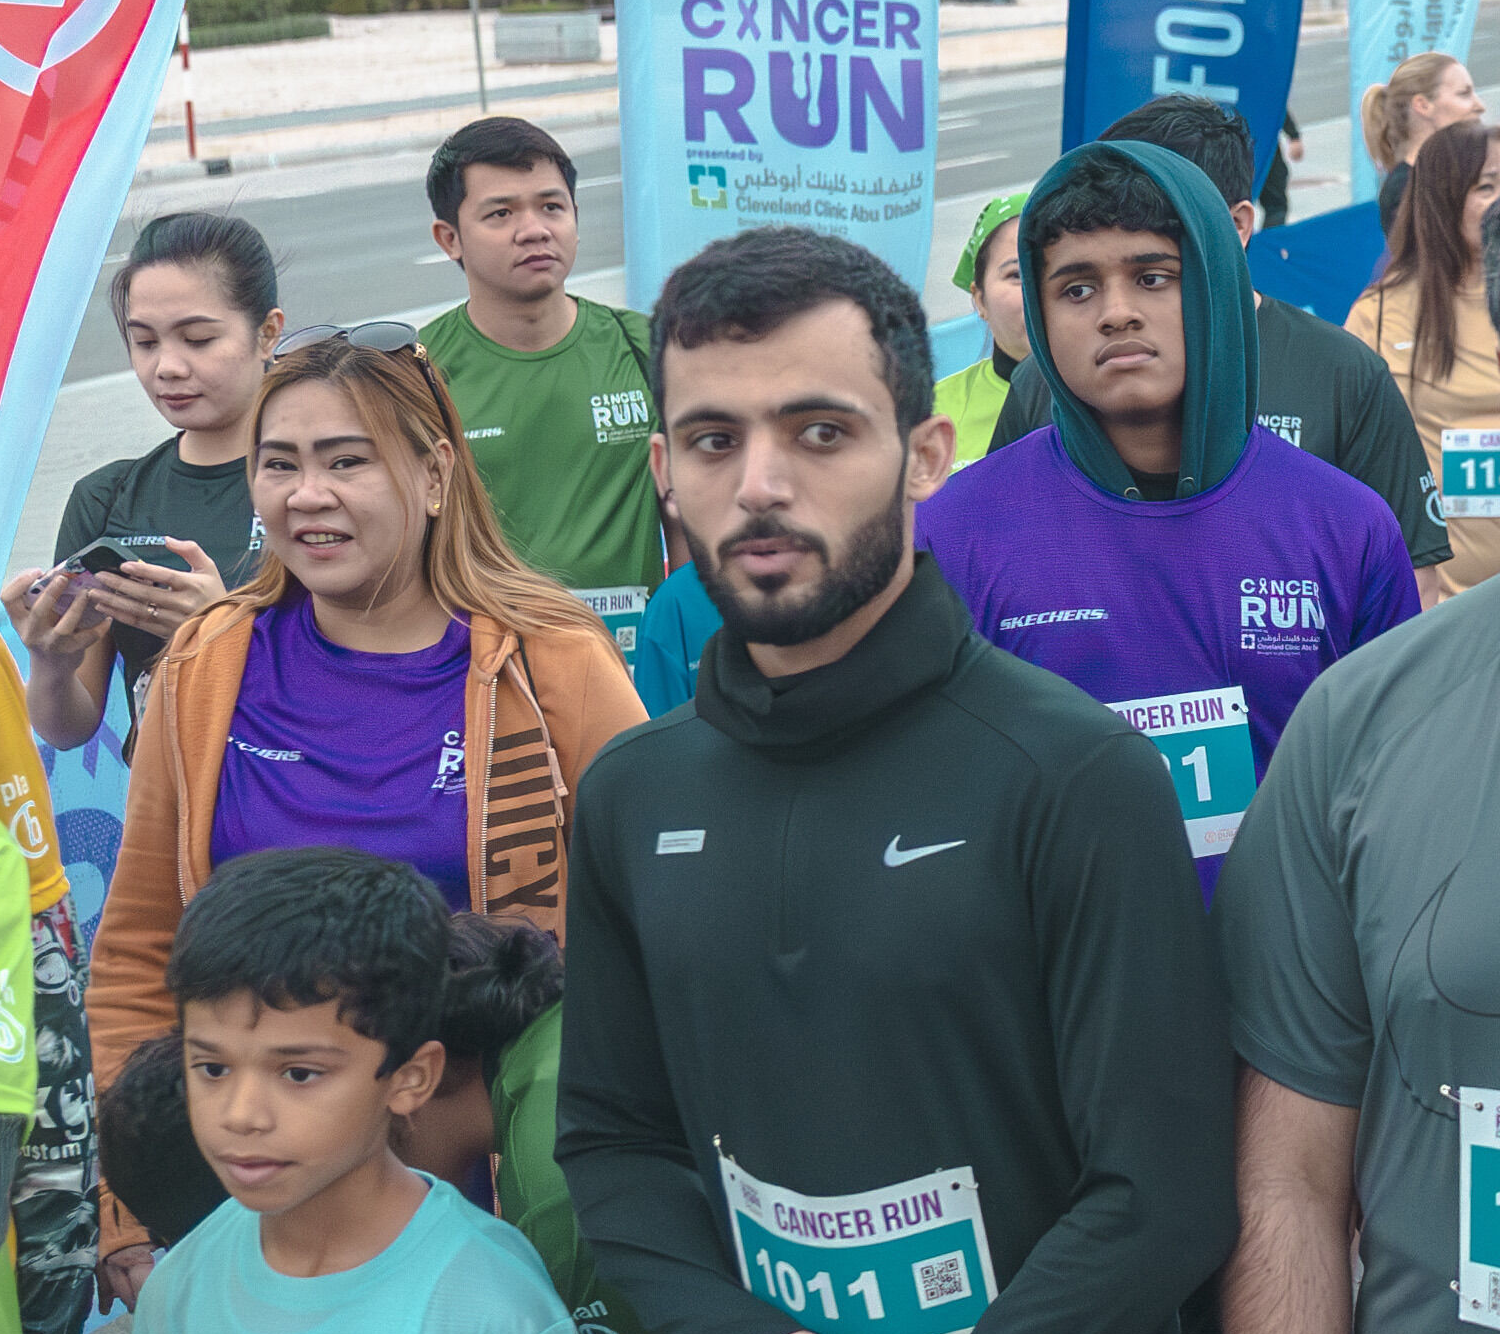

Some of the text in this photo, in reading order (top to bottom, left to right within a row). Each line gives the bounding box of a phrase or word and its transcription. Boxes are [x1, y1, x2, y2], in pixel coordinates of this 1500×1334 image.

[682, 47, 925, 154] RUN
[735, 195, 813, 217] Cleveland
[814, 200, 848, 221] Clinic
[850, 203, 880, 223] Abu
[590, 389, 645, 408] CANCER
[592, 403, 649, 429] RUN
[1240, 577, 1320, 598] CANCER
[610, 593, 634, 611] RUN
[1240, 596, 1325, 630] RUN
[1000, 608, 1106, 631] SKECHERS
[1180, 696, 1225, 725] RUN
[774, 1189, 943, 1240] CANCER RUN
[756, 1248, 886, 1320] 1011
